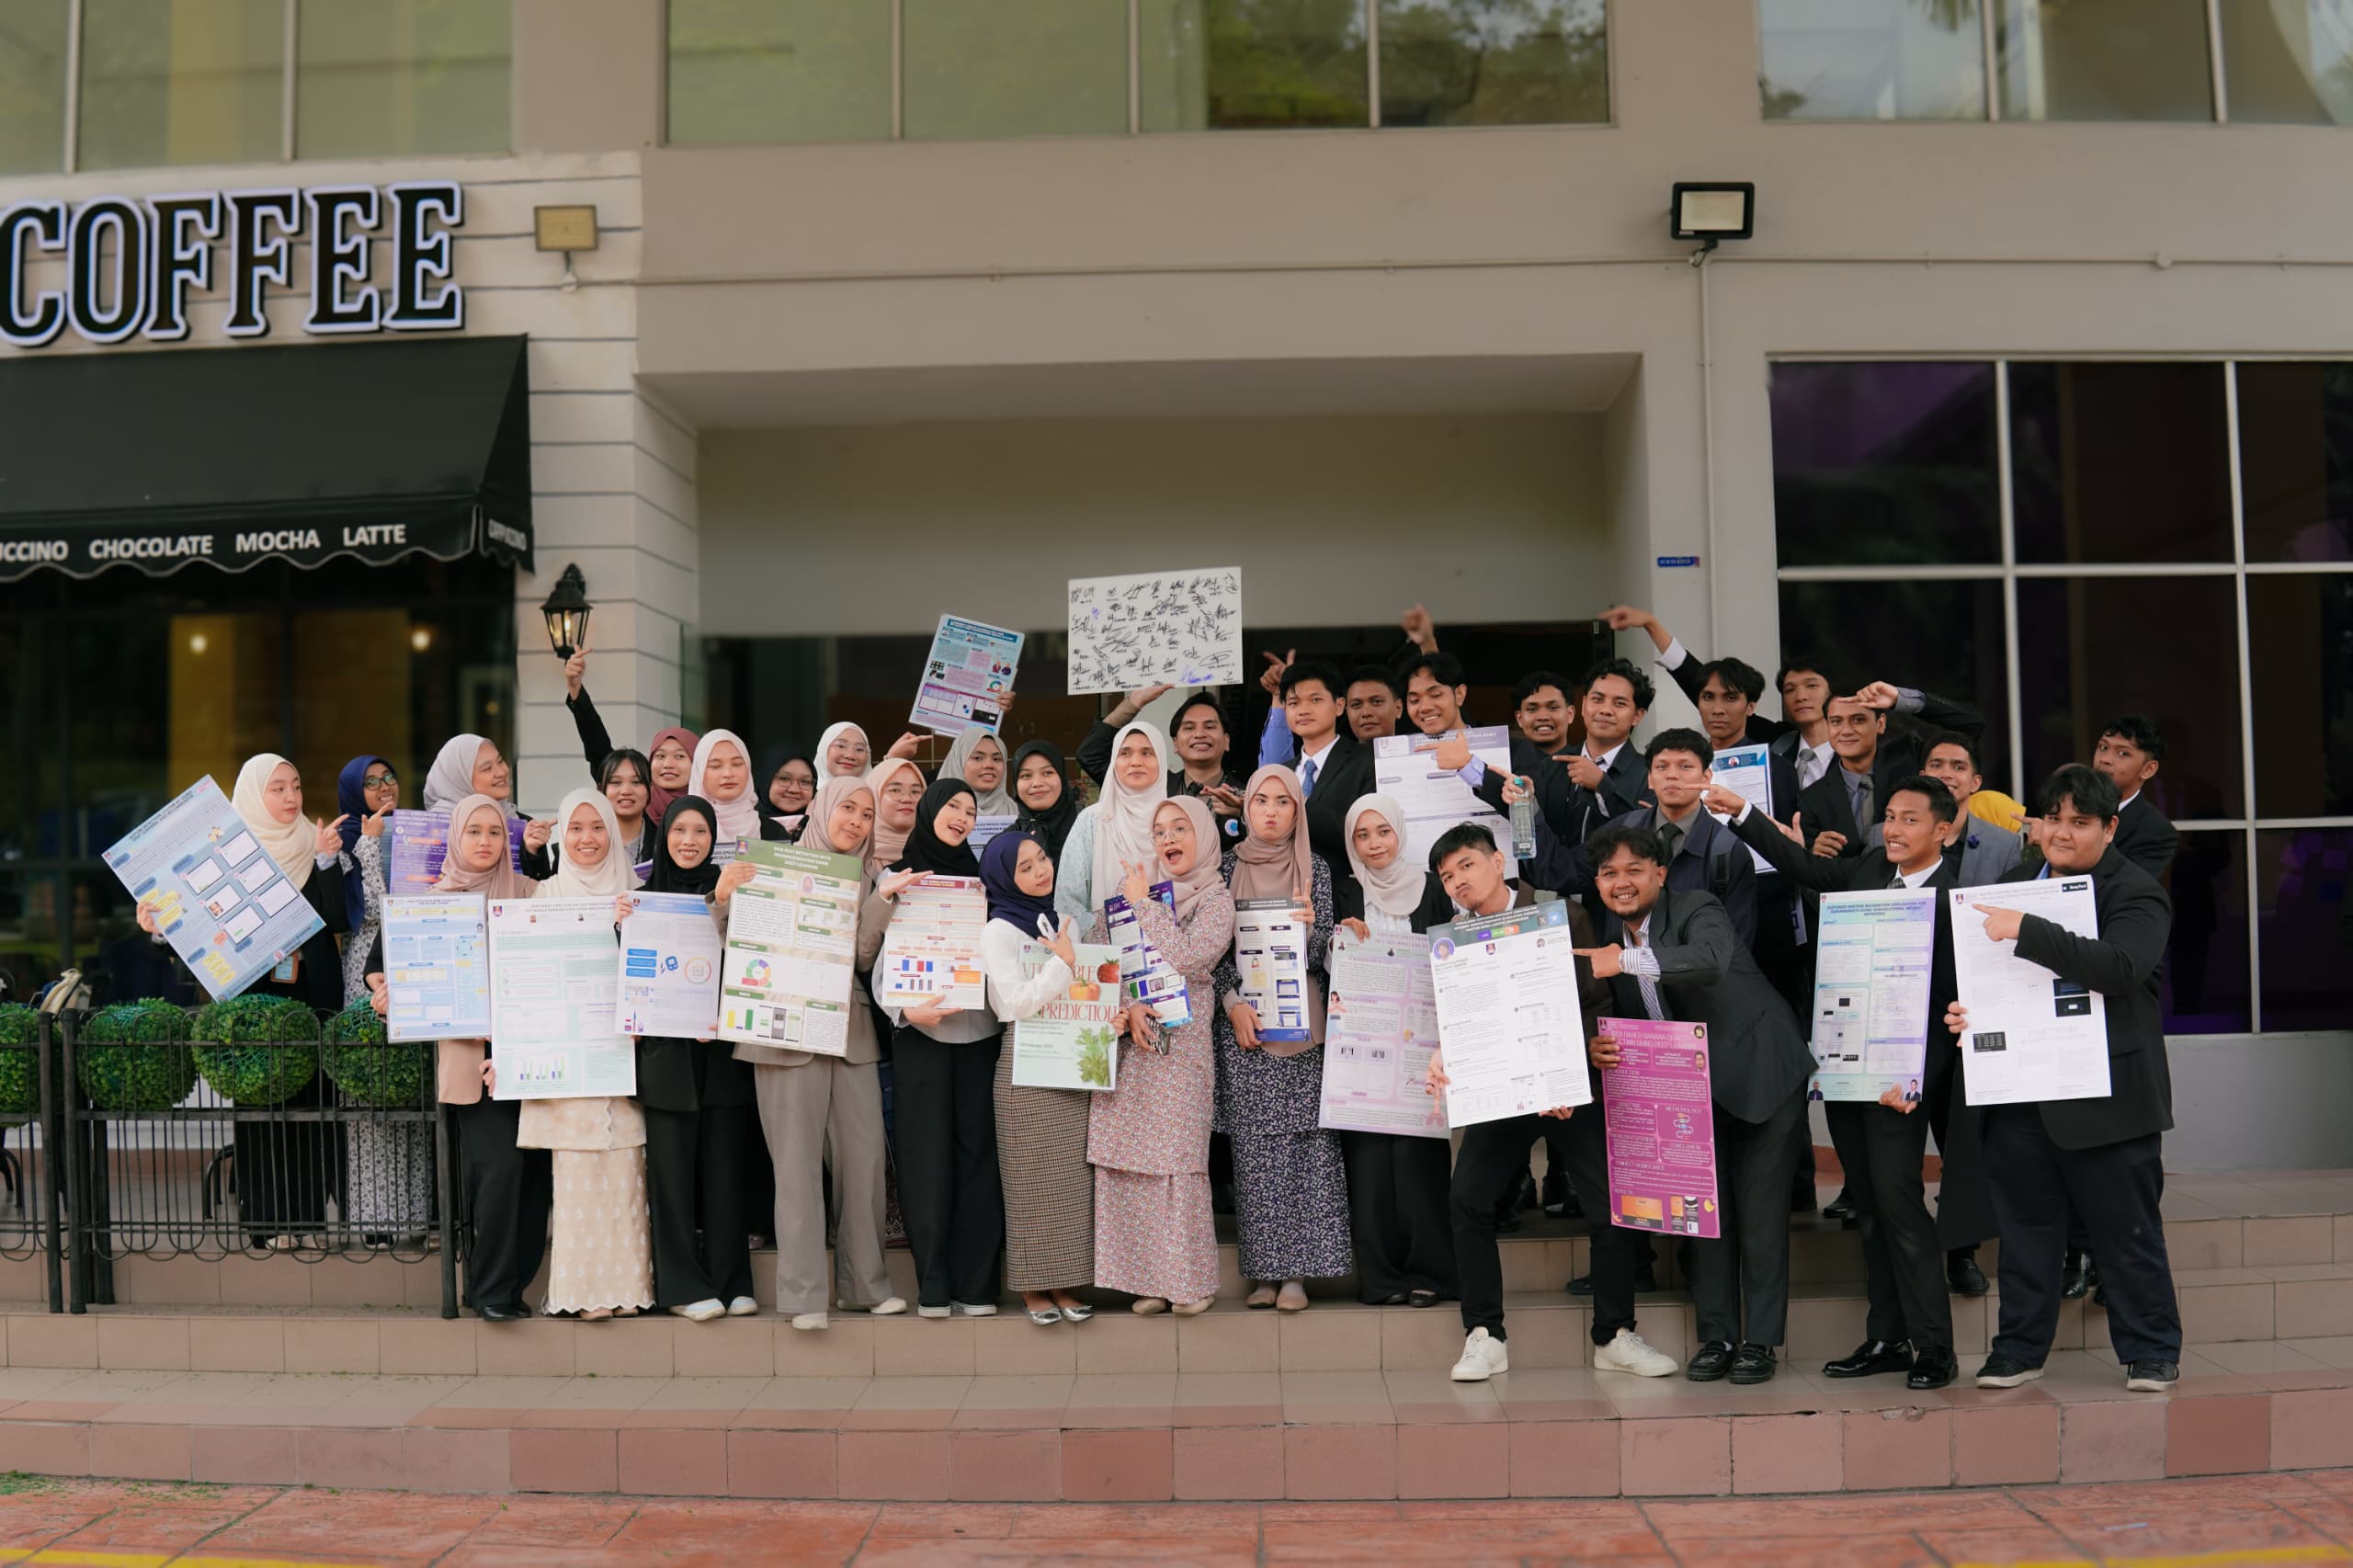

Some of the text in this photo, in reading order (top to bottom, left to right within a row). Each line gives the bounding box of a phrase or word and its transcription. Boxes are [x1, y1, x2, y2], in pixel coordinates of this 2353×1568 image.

[0, 181, 462, 347] COFFEE
[0, 524, 406, 562] CCINO CHOCOLATE MOCHA LATTE
[1040, 1001, 1118, 1022] PREDICTION
